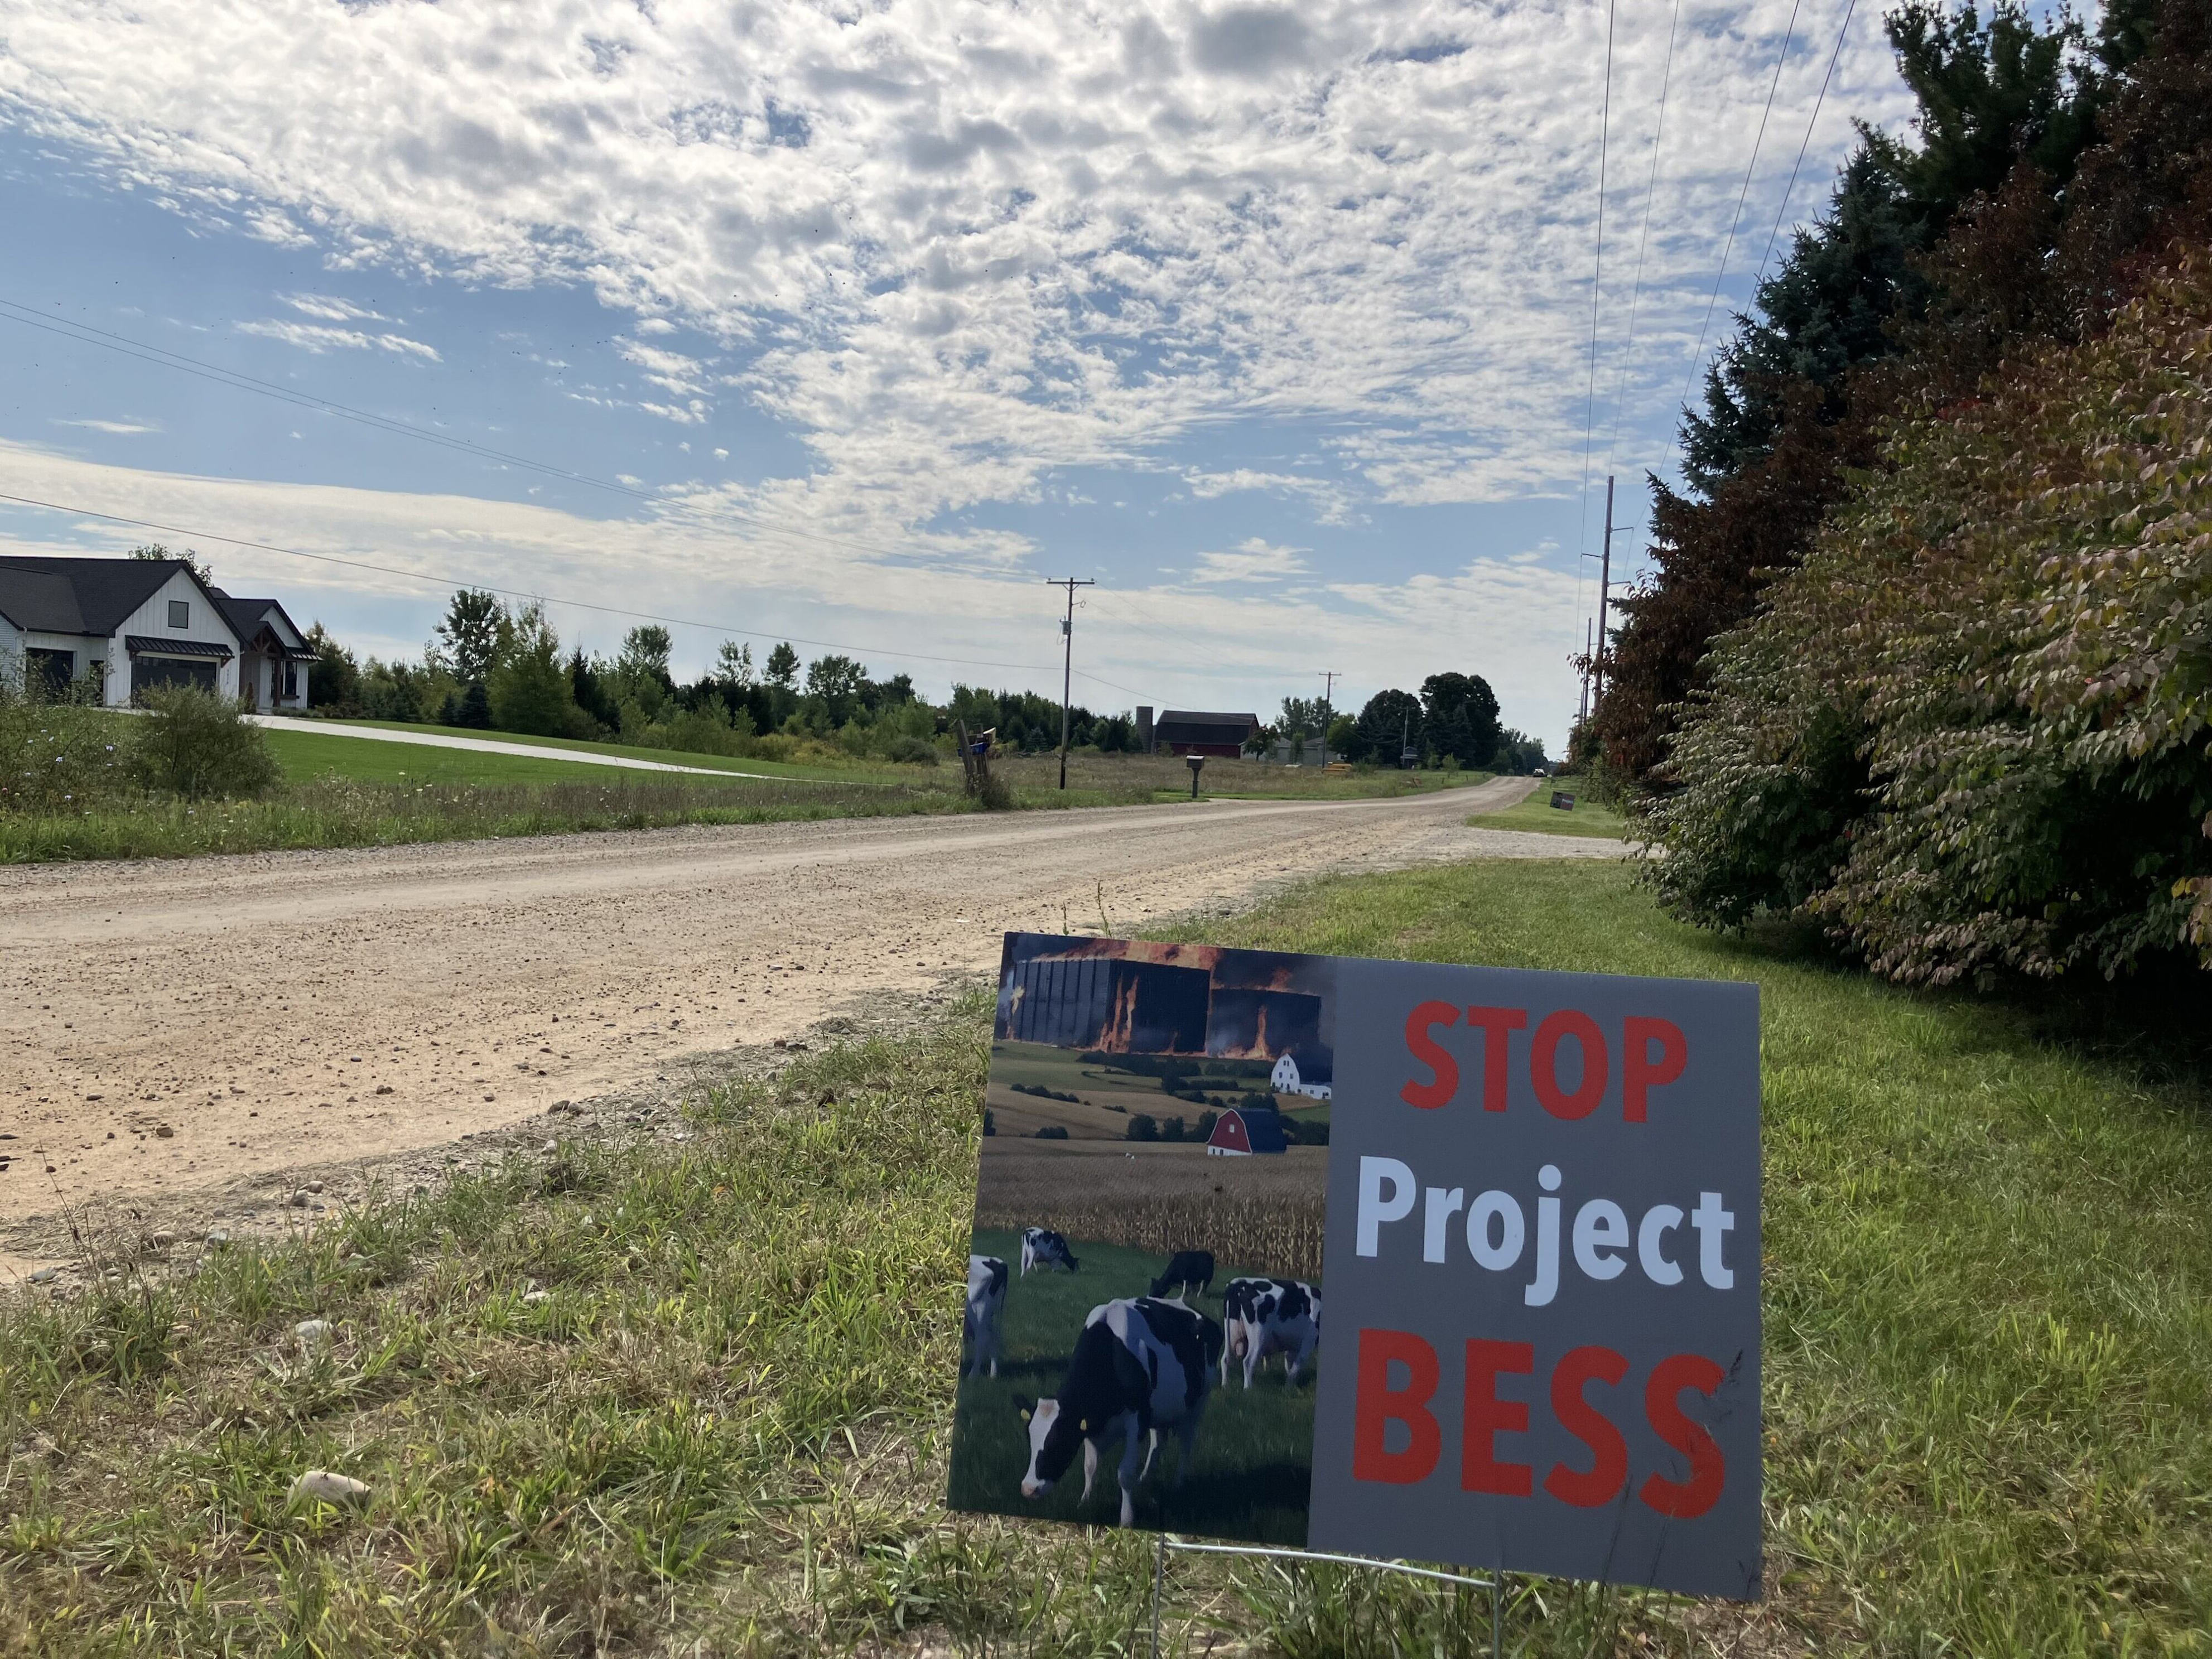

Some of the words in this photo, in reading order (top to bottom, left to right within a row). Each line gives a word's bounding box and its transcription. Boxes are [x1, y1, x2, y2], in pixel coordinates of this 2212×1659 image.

[1399, 1000, 1688, 1123] STOP
[1356, 1156, 1734, 1306] Project
[1353, 1329, 1726, 1518] BESS
